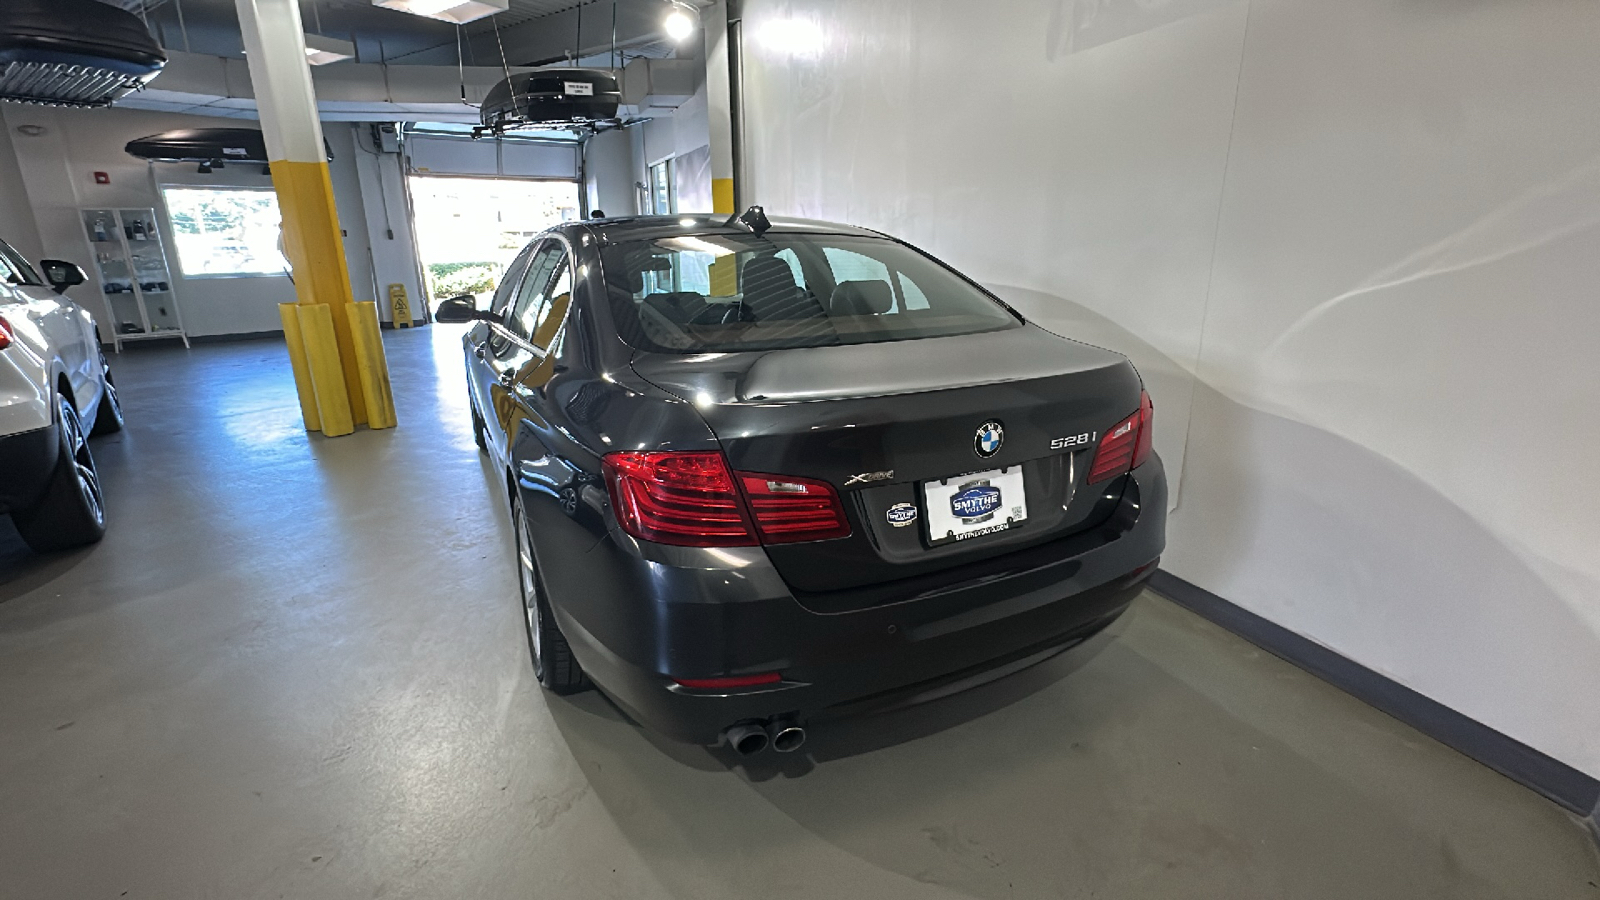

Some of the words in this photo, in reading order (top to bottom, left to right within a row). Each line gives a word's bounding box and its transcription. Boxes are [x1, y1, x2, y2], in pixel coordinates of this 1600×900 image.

[977, 422, 1003, 437] BMW
[954, 494, 998, 511] SMYTHE
[964, 503, 991, 514] VOLVO
